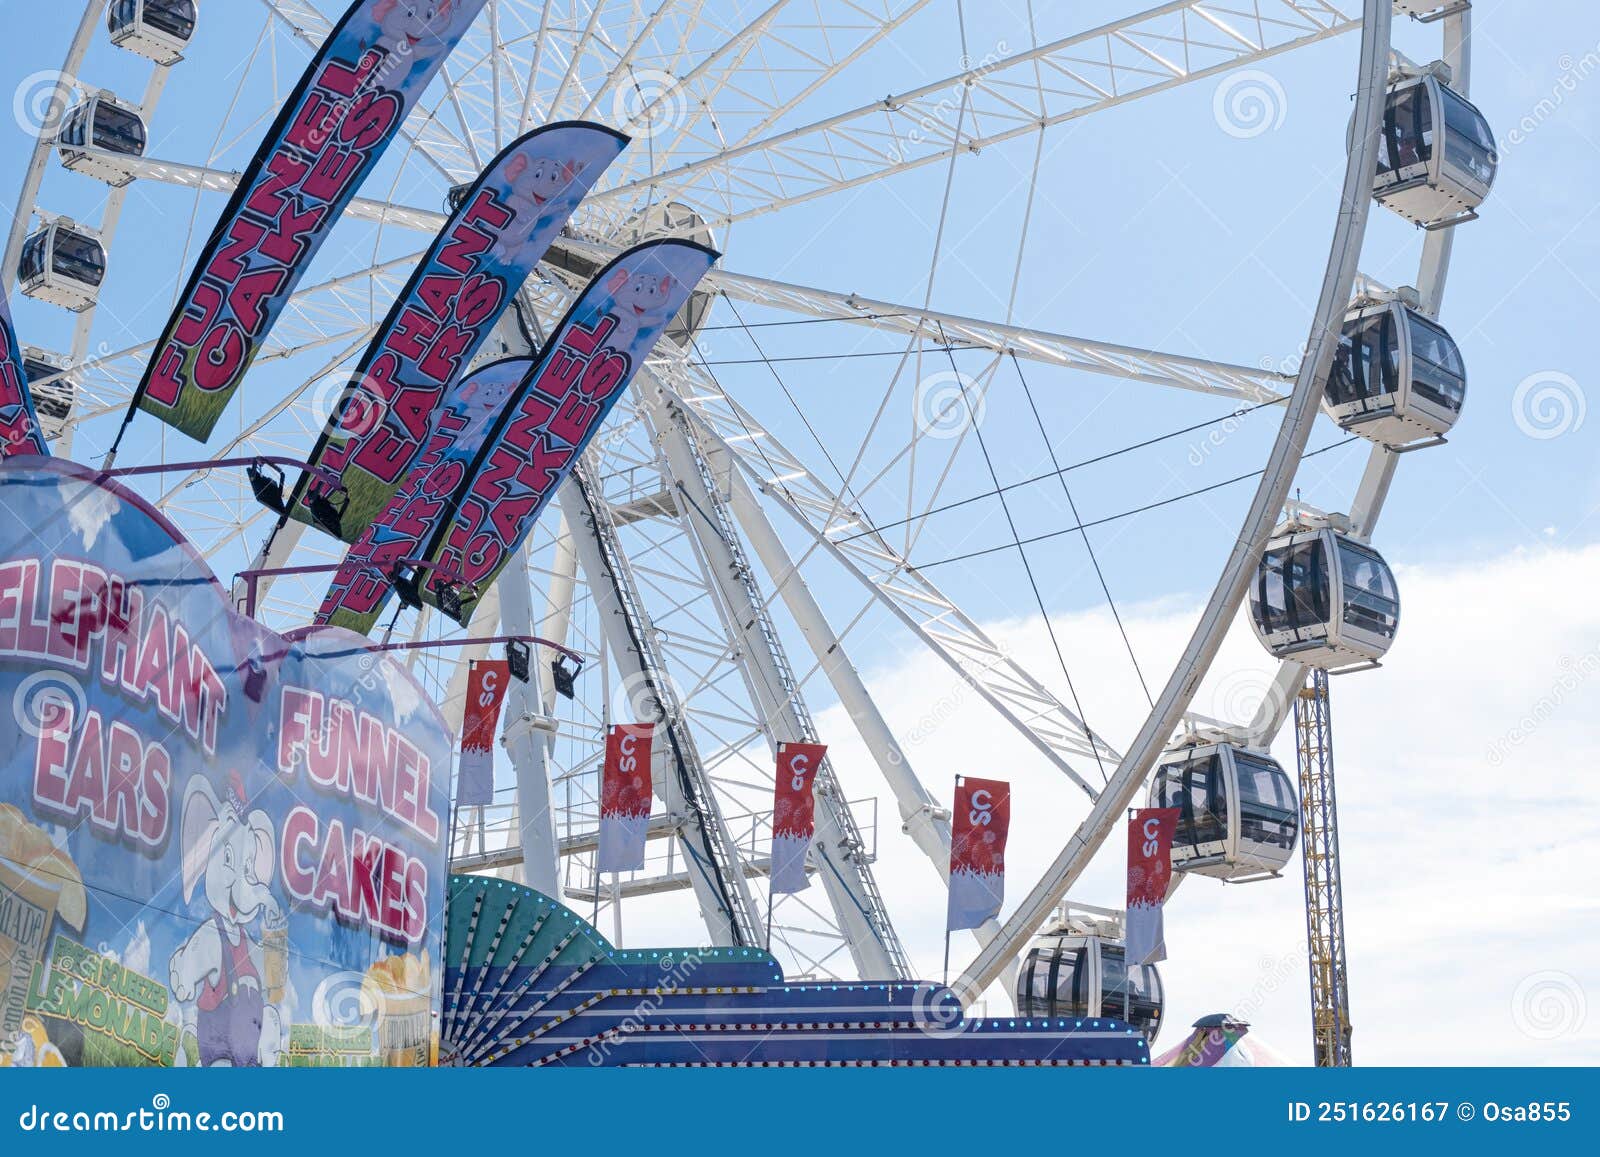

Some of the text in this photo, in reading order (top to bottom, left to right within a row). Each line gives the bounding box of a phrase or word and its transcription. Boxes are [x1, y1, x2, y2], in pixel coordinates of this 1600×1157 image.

[144, 49, 386, 408] FUNNEL
[193, 89, 400, 394] CAKES
[350, 273, 504, 485] EARS
[424, 316, 616, 594] FUNNEL
[463, 349, 627, 585] CAKES
[313, 408, 471, 625] LEPHANT
[340, 458, 466, 614] EARS
[0, 558, 227, 755] ELEPHANT
[33, 698, 171, 846] EARS
[278, 685, 439, 842] FUNNEL
[281, 806, 428, 943] CAKES
[25, 960, 179, 1066] LEMONADE
